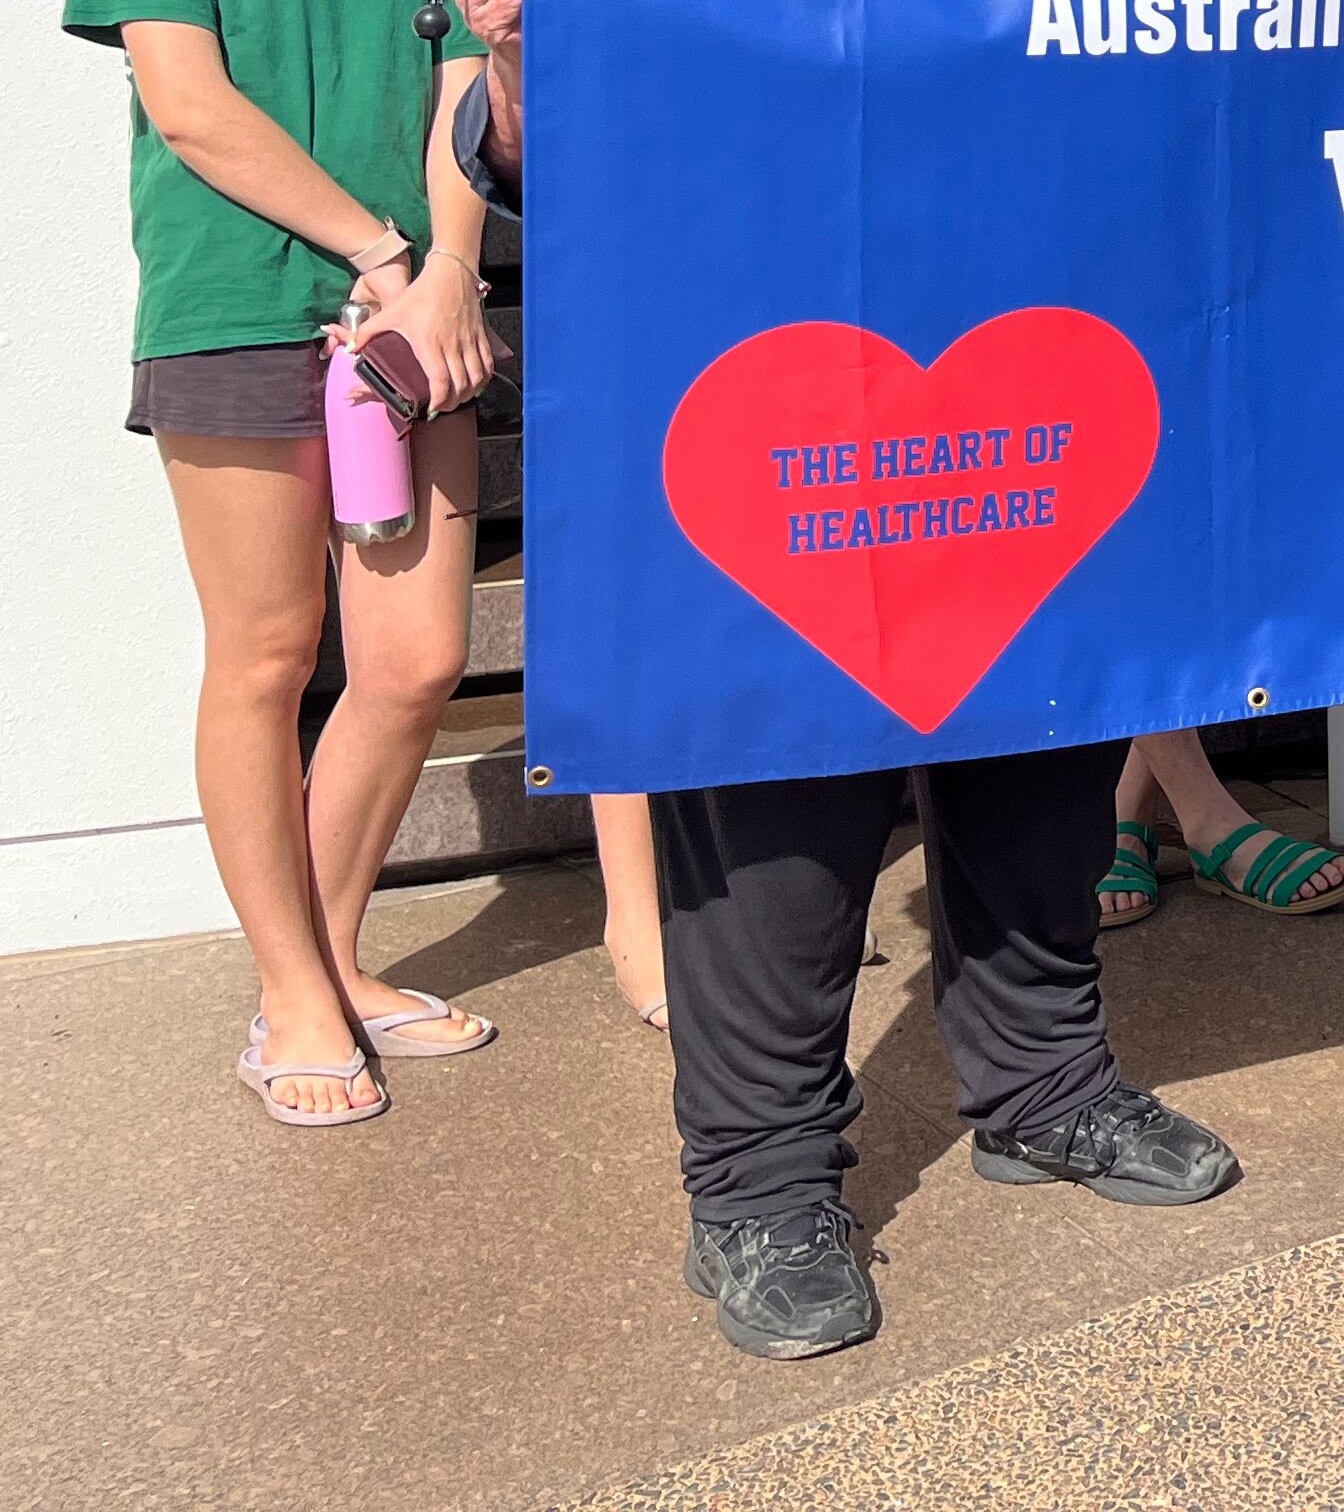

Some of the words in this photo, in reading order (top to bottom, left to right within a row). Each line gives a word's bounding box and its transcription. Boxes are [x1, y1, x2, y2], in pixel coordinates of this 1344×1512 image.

[770, 443, 858, 488] THE
[871, 429, 1010, 480] HEART
[1024, 423, 1072, 463] OF
[786, 487, 1056, 554] HEALTHCARE
